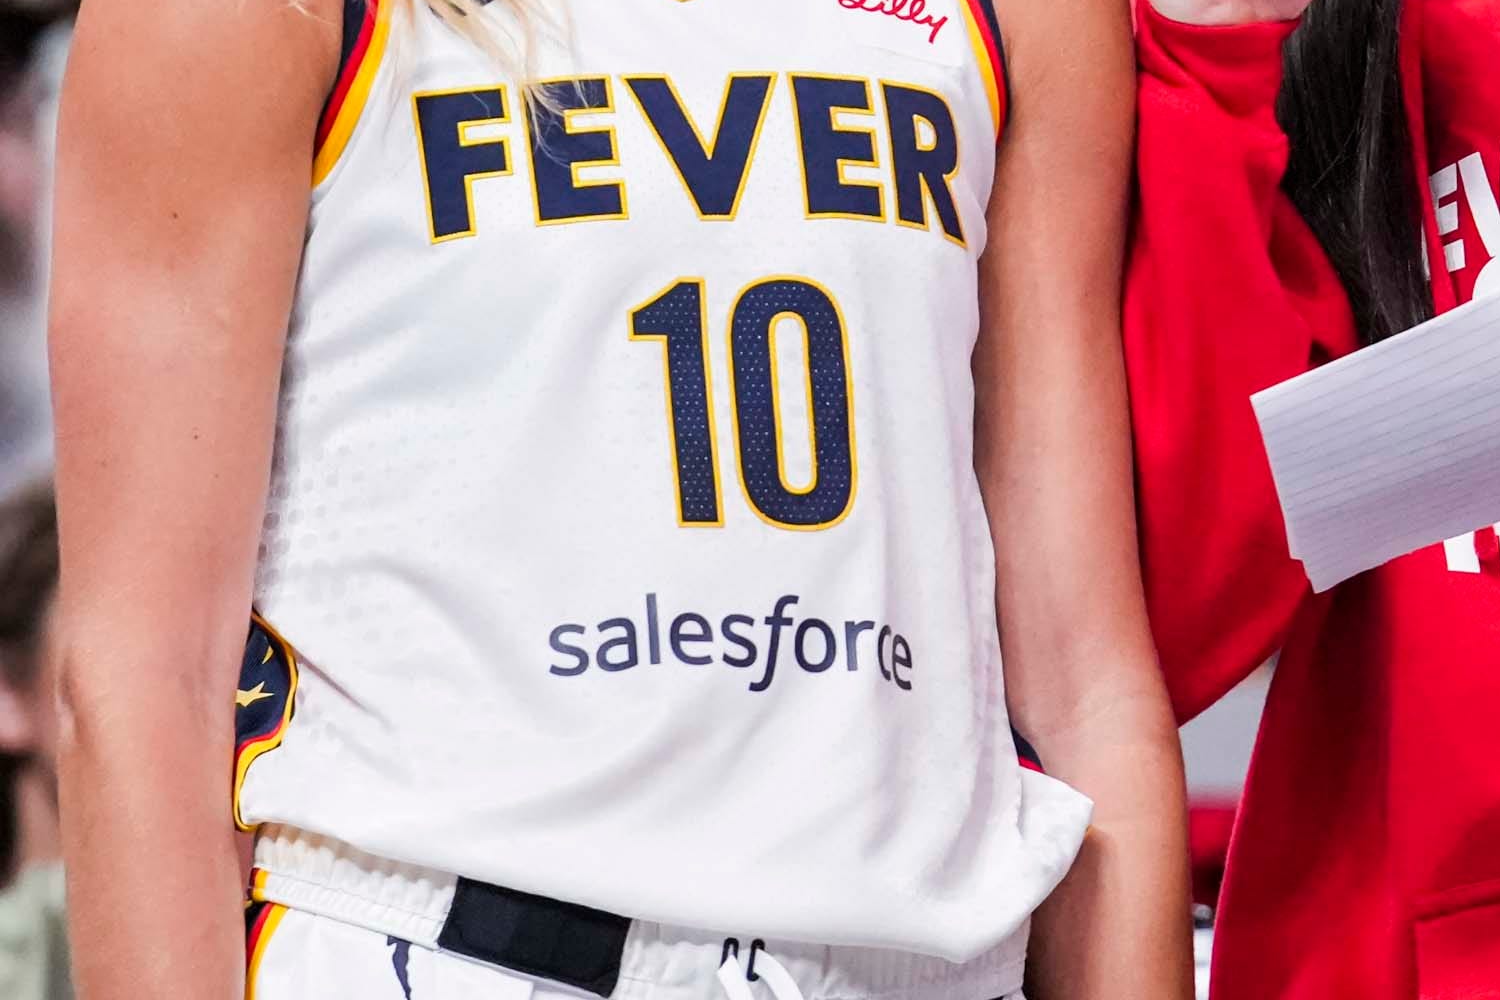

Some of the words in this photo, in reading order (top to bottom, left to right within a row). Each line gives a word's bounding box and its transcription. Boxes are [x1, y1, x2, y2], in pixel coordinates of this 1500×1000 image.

[411, 70, 968, 250] FEVER
[627, 275, 858, 531] 10
[548, 592, 913, 692] salesforce
